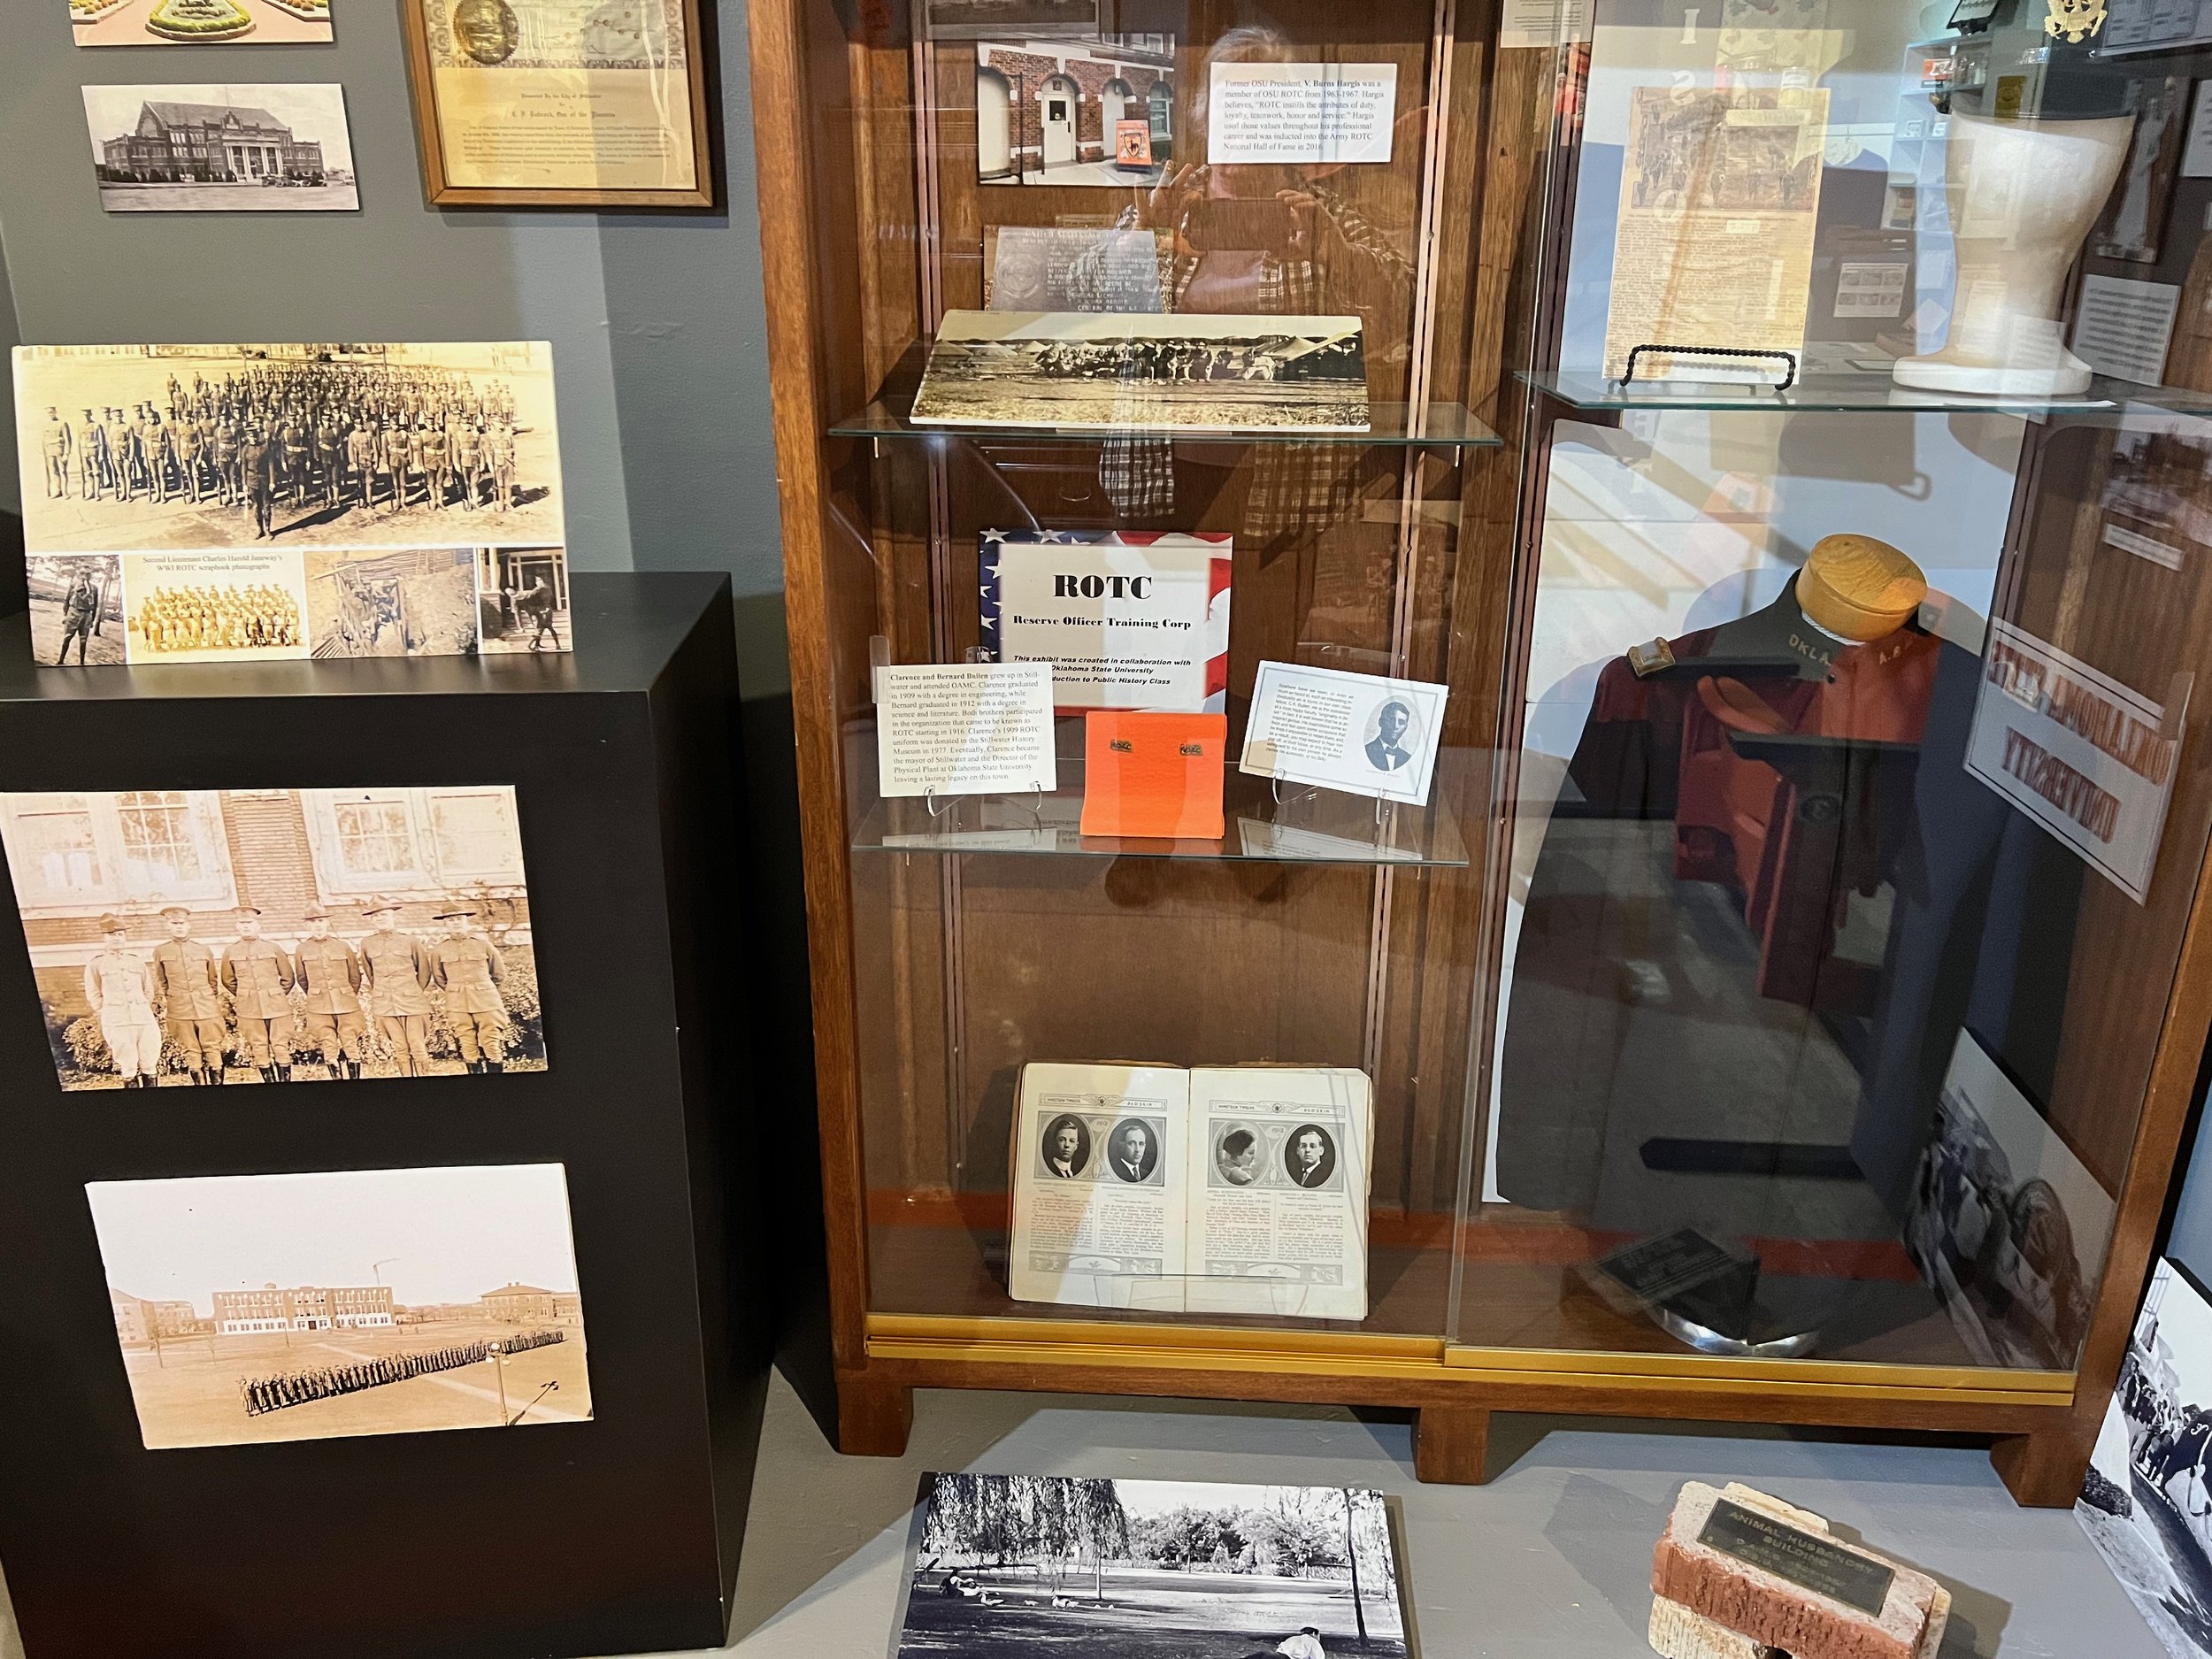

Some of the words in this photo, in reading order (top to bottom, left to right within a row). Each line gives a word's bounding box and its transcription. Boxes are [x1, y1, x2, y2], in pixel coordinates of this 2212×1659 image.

[1336, 80, 1360, 88] Hargis
[1362, 90, 1384, 99] Hargis
[1359, 101, 1376, 110] duty,
[1224, 111, 1248, 120] loyalty,
[1352, 111, 1373, 120] Hargis
[1282, 122, 1317, 131] throughout
[1332, 121, 1371, 131] professional
[1329, 132, 1348, 141] Army
[1053, 575, 1151, 599] ROTC
[1013, 616, 1059, 625] Reserve
[1064, 617, 1102, 626] Officer
[1107, 618, 1158, 628] Training
[1163, 619, 1191, 630] Corp
[1008, 680, 1038, 689] graduated
[937, 691, 958, 700] degree
[968, 690, 1006, 699] engineering,
[1005, 707, 1041, 717] participated
[915, 728, 939, 737] starting
[1011, 734, 1033, 743] History
[950, 746, 985, 755] Eventually,
[894, 766, 920, 775] Physical
[1000, 763, 1031, 772] University
[895, 775, 917, 784] leaving
[925, 774, 945, 783] lasting
[948, 773, 967, 782] legacy
[1730, 1511, 1782, 1537] ANIMAL
[1788, 1534, 1874, 1573] HUSBANDRY
[1763, 1536, 1829, 1567] BUILDING
